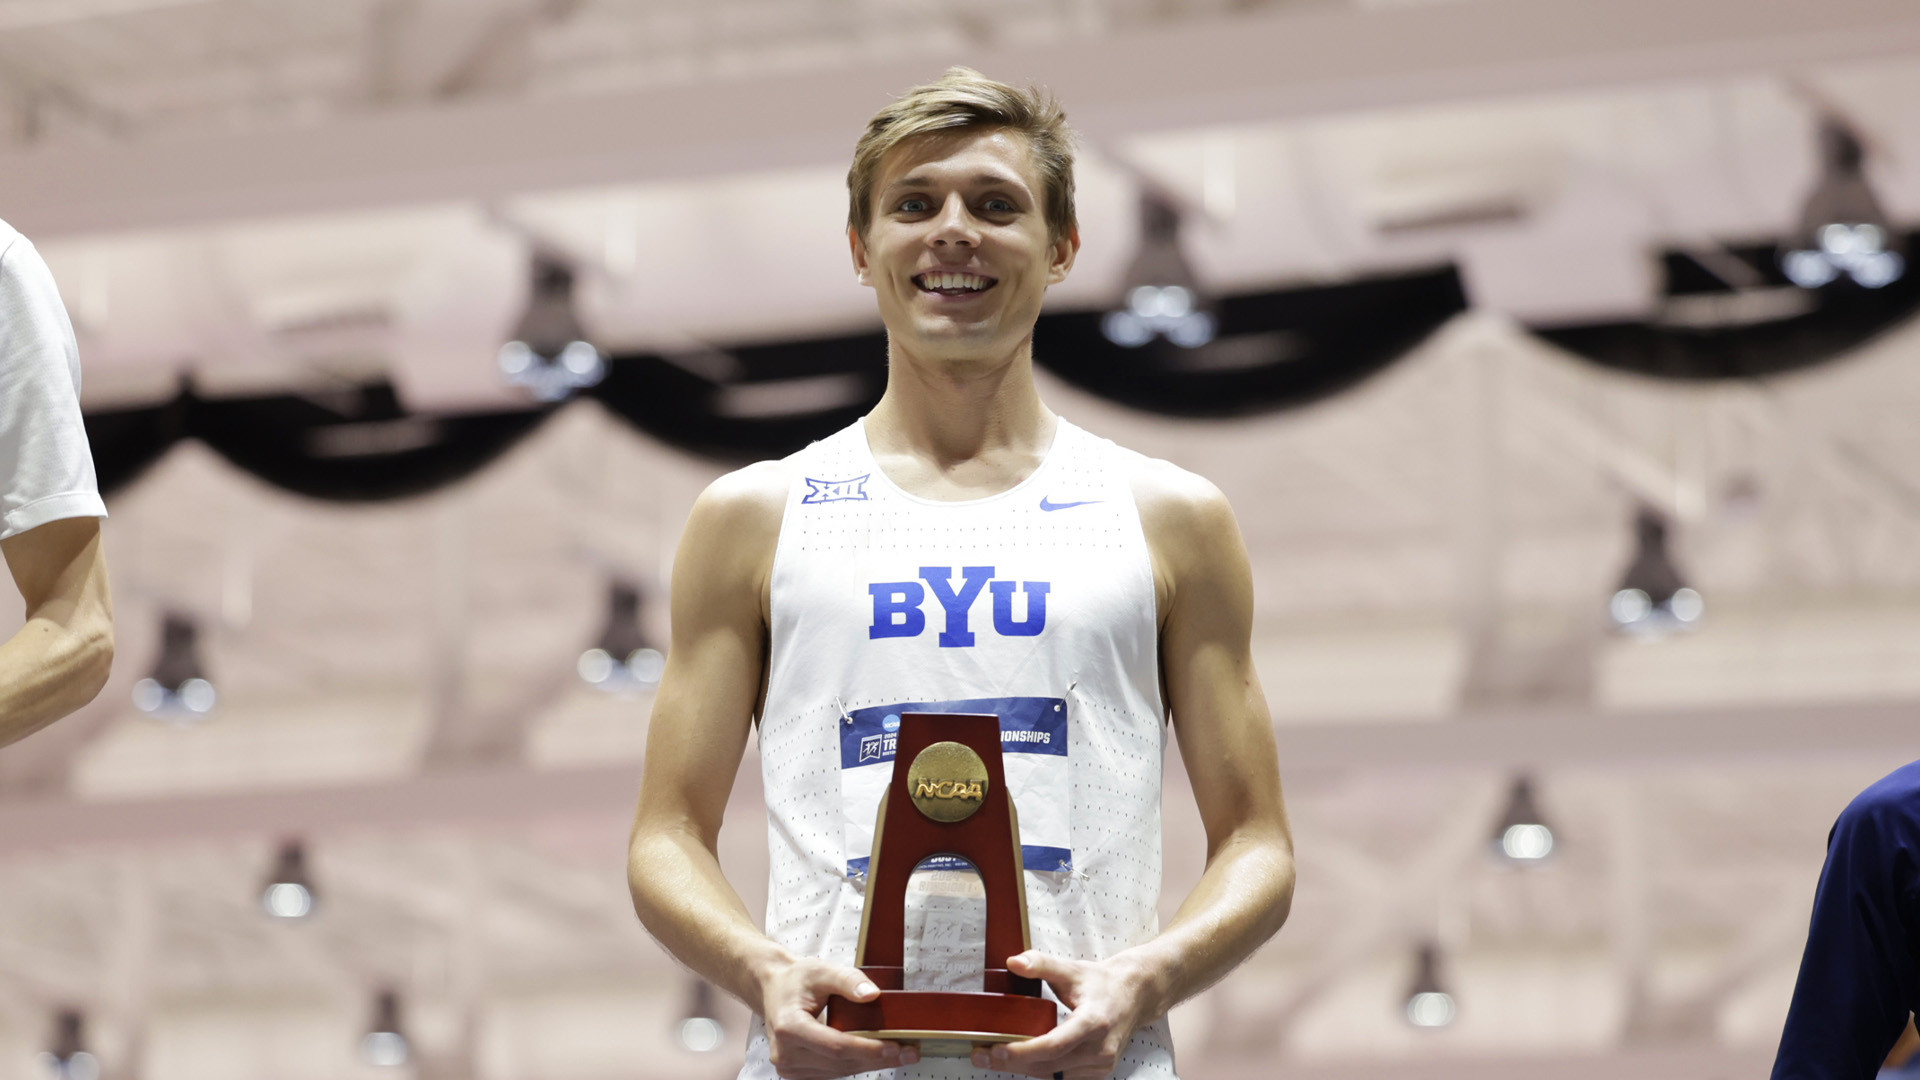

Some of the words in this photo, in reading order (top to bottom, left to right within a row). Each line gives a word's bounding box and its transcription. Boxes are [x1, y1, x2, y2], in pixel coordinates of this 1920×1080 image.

[868, 566, 1051, 648] BYU
[883, 738, 897, 751] TR
[1001, 730, 1051, 744] IONSHIPS
[915, 778, 983, 800] NCAA
